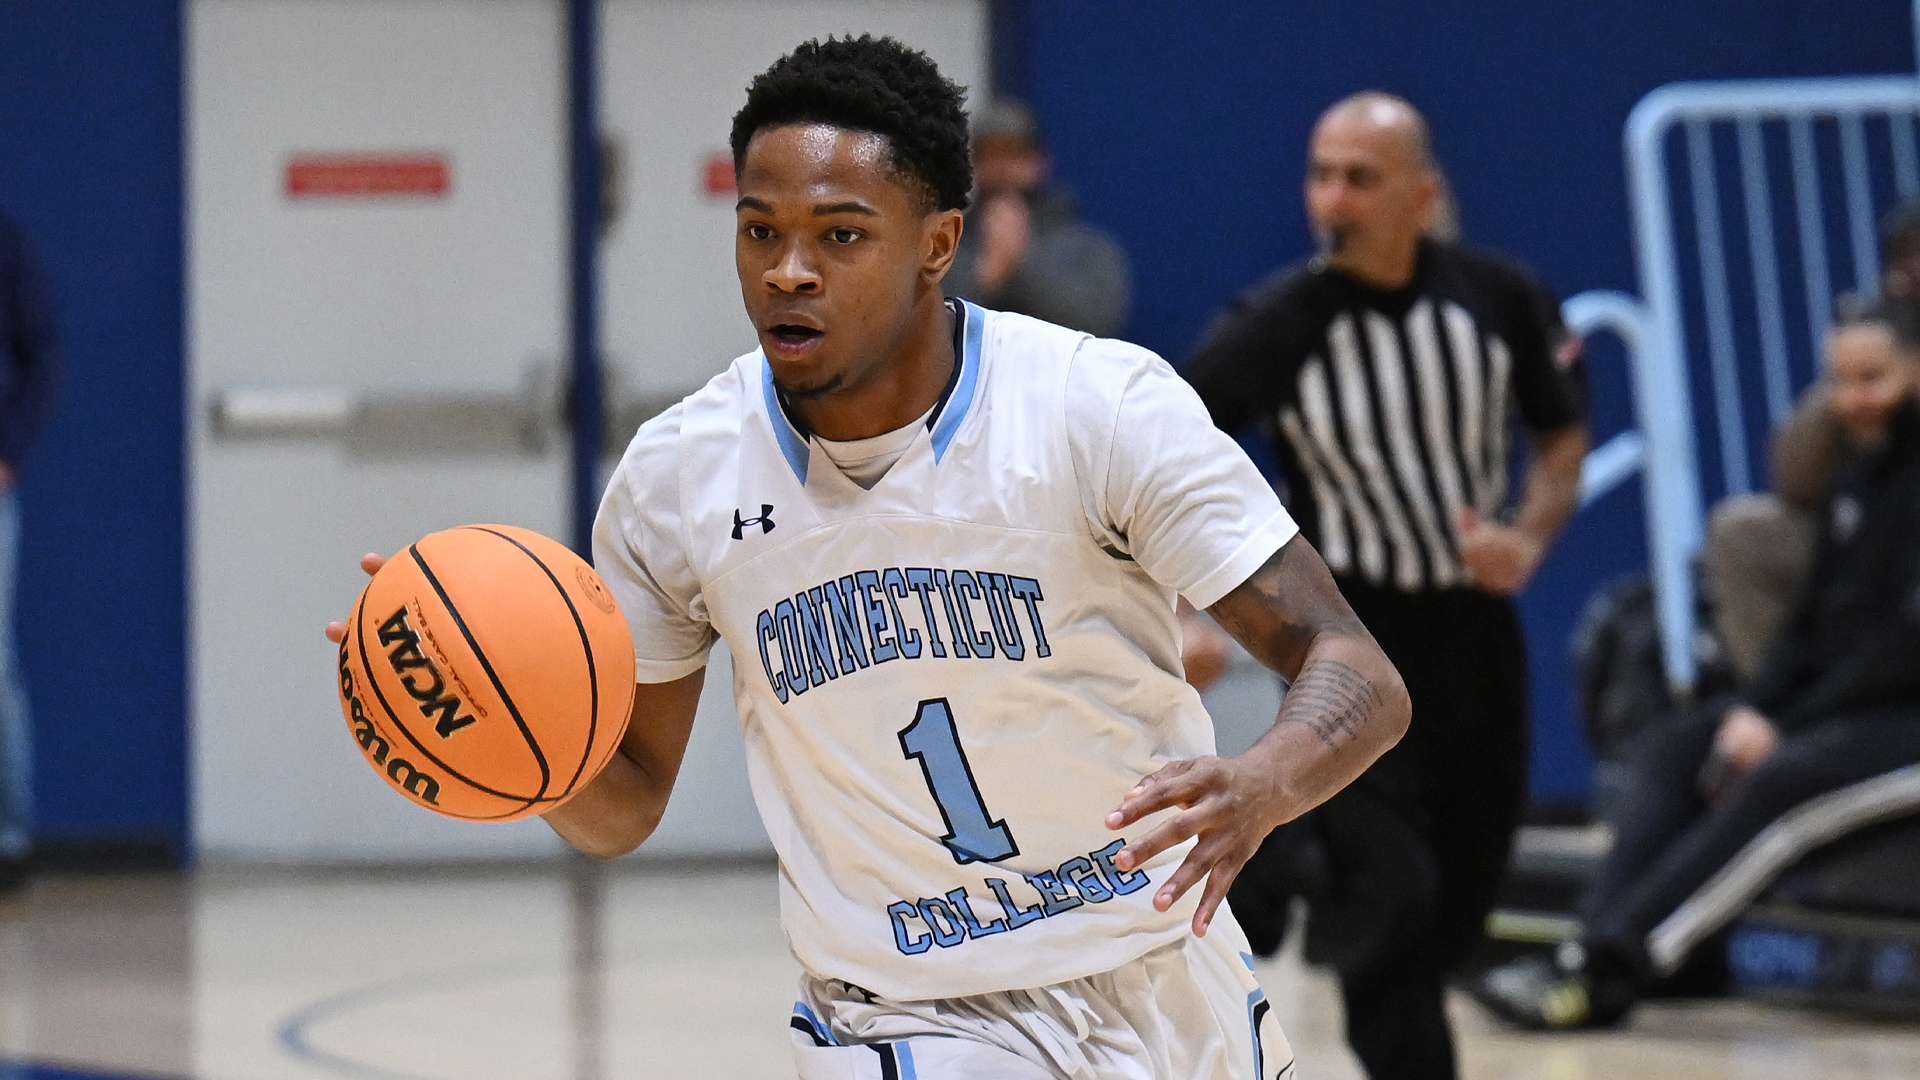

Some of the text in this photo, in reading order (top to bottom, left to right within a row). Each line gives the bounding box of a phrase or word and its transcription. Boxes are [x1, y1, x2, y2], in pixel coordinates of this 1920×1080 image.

[376, 604, 477, 739] NCAA
[756, 566, 1052, 705] CONNECTICUT
[339, 618, 440, 806] Wilson
[897, 696, 1021, 866] 1
[886, 838, 1152, 956] COLLEGE
